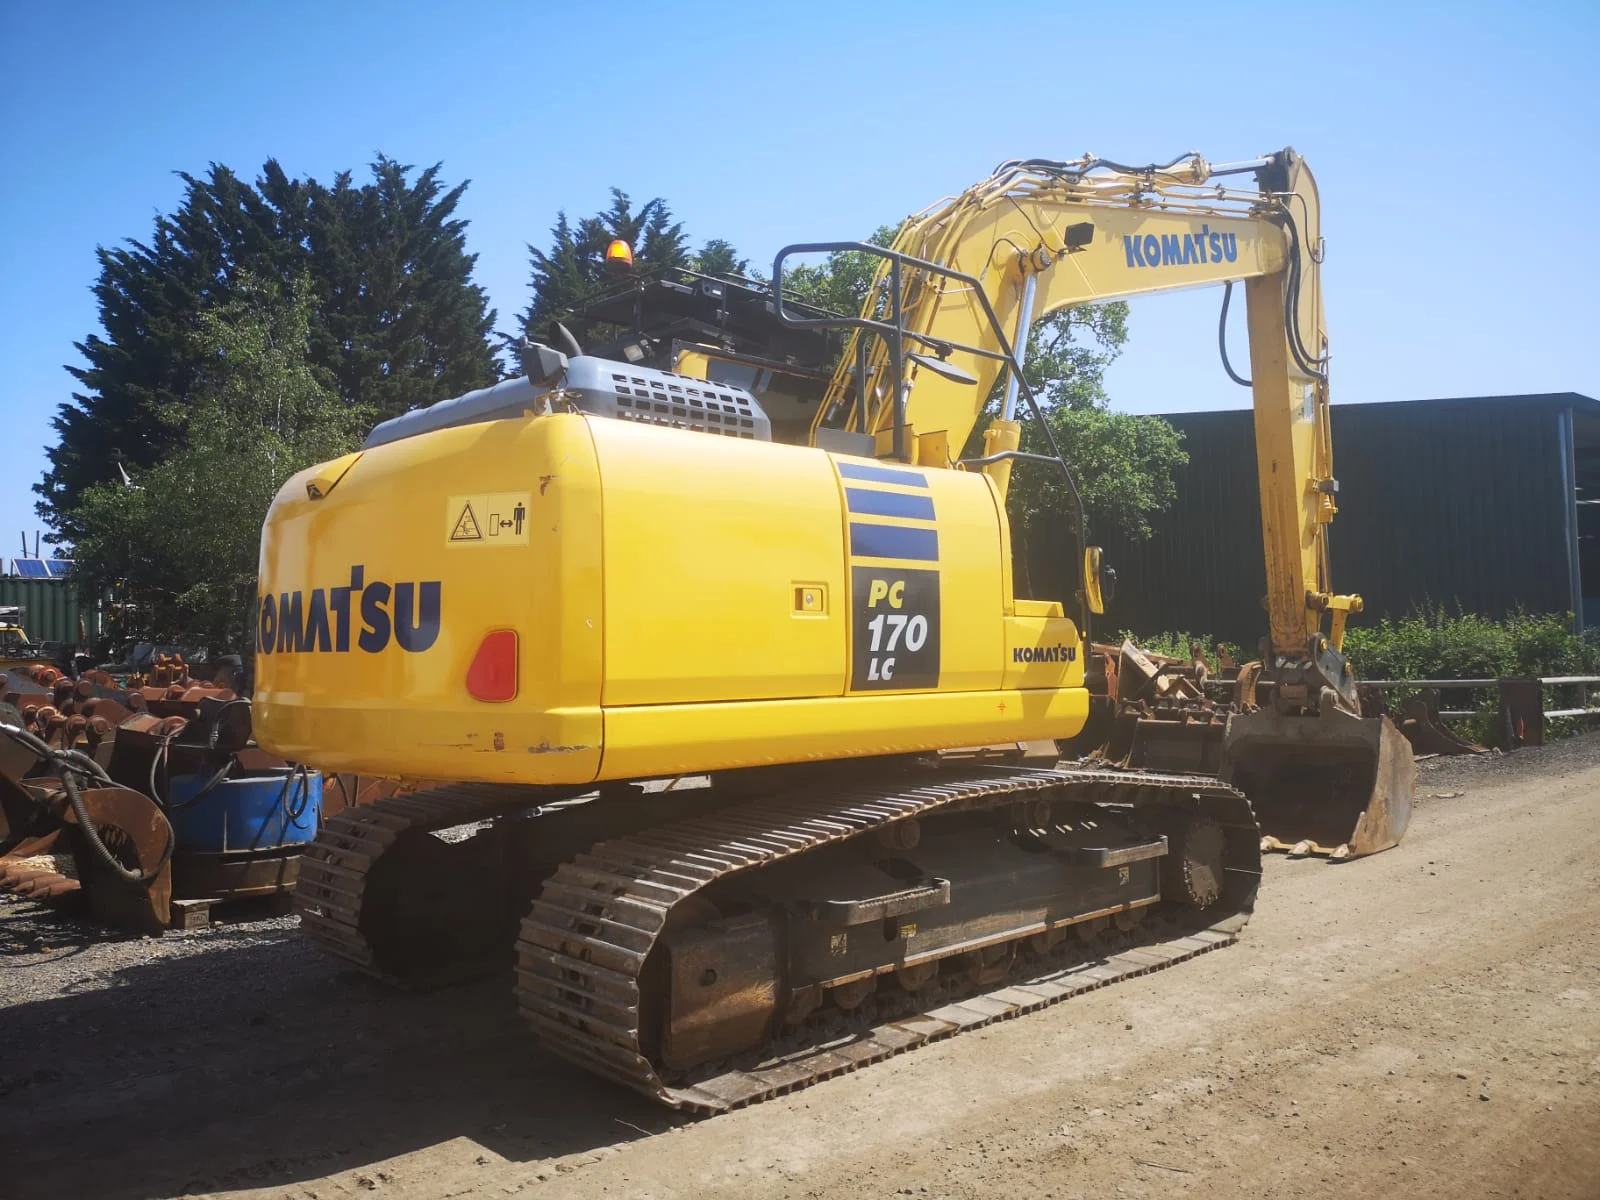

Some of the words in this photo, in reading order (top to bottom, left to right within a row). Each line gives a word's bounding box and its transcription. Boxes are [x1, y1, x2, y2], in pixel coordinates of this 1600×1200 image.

[1123, 224, 1237, 268] KOMATSU
[868, 579, 905, 608] PC
[868, 614, 928, 652] 170
[1013, 643, 1076, 663] KOMATSU
[867, 657, 895, 680] LC
